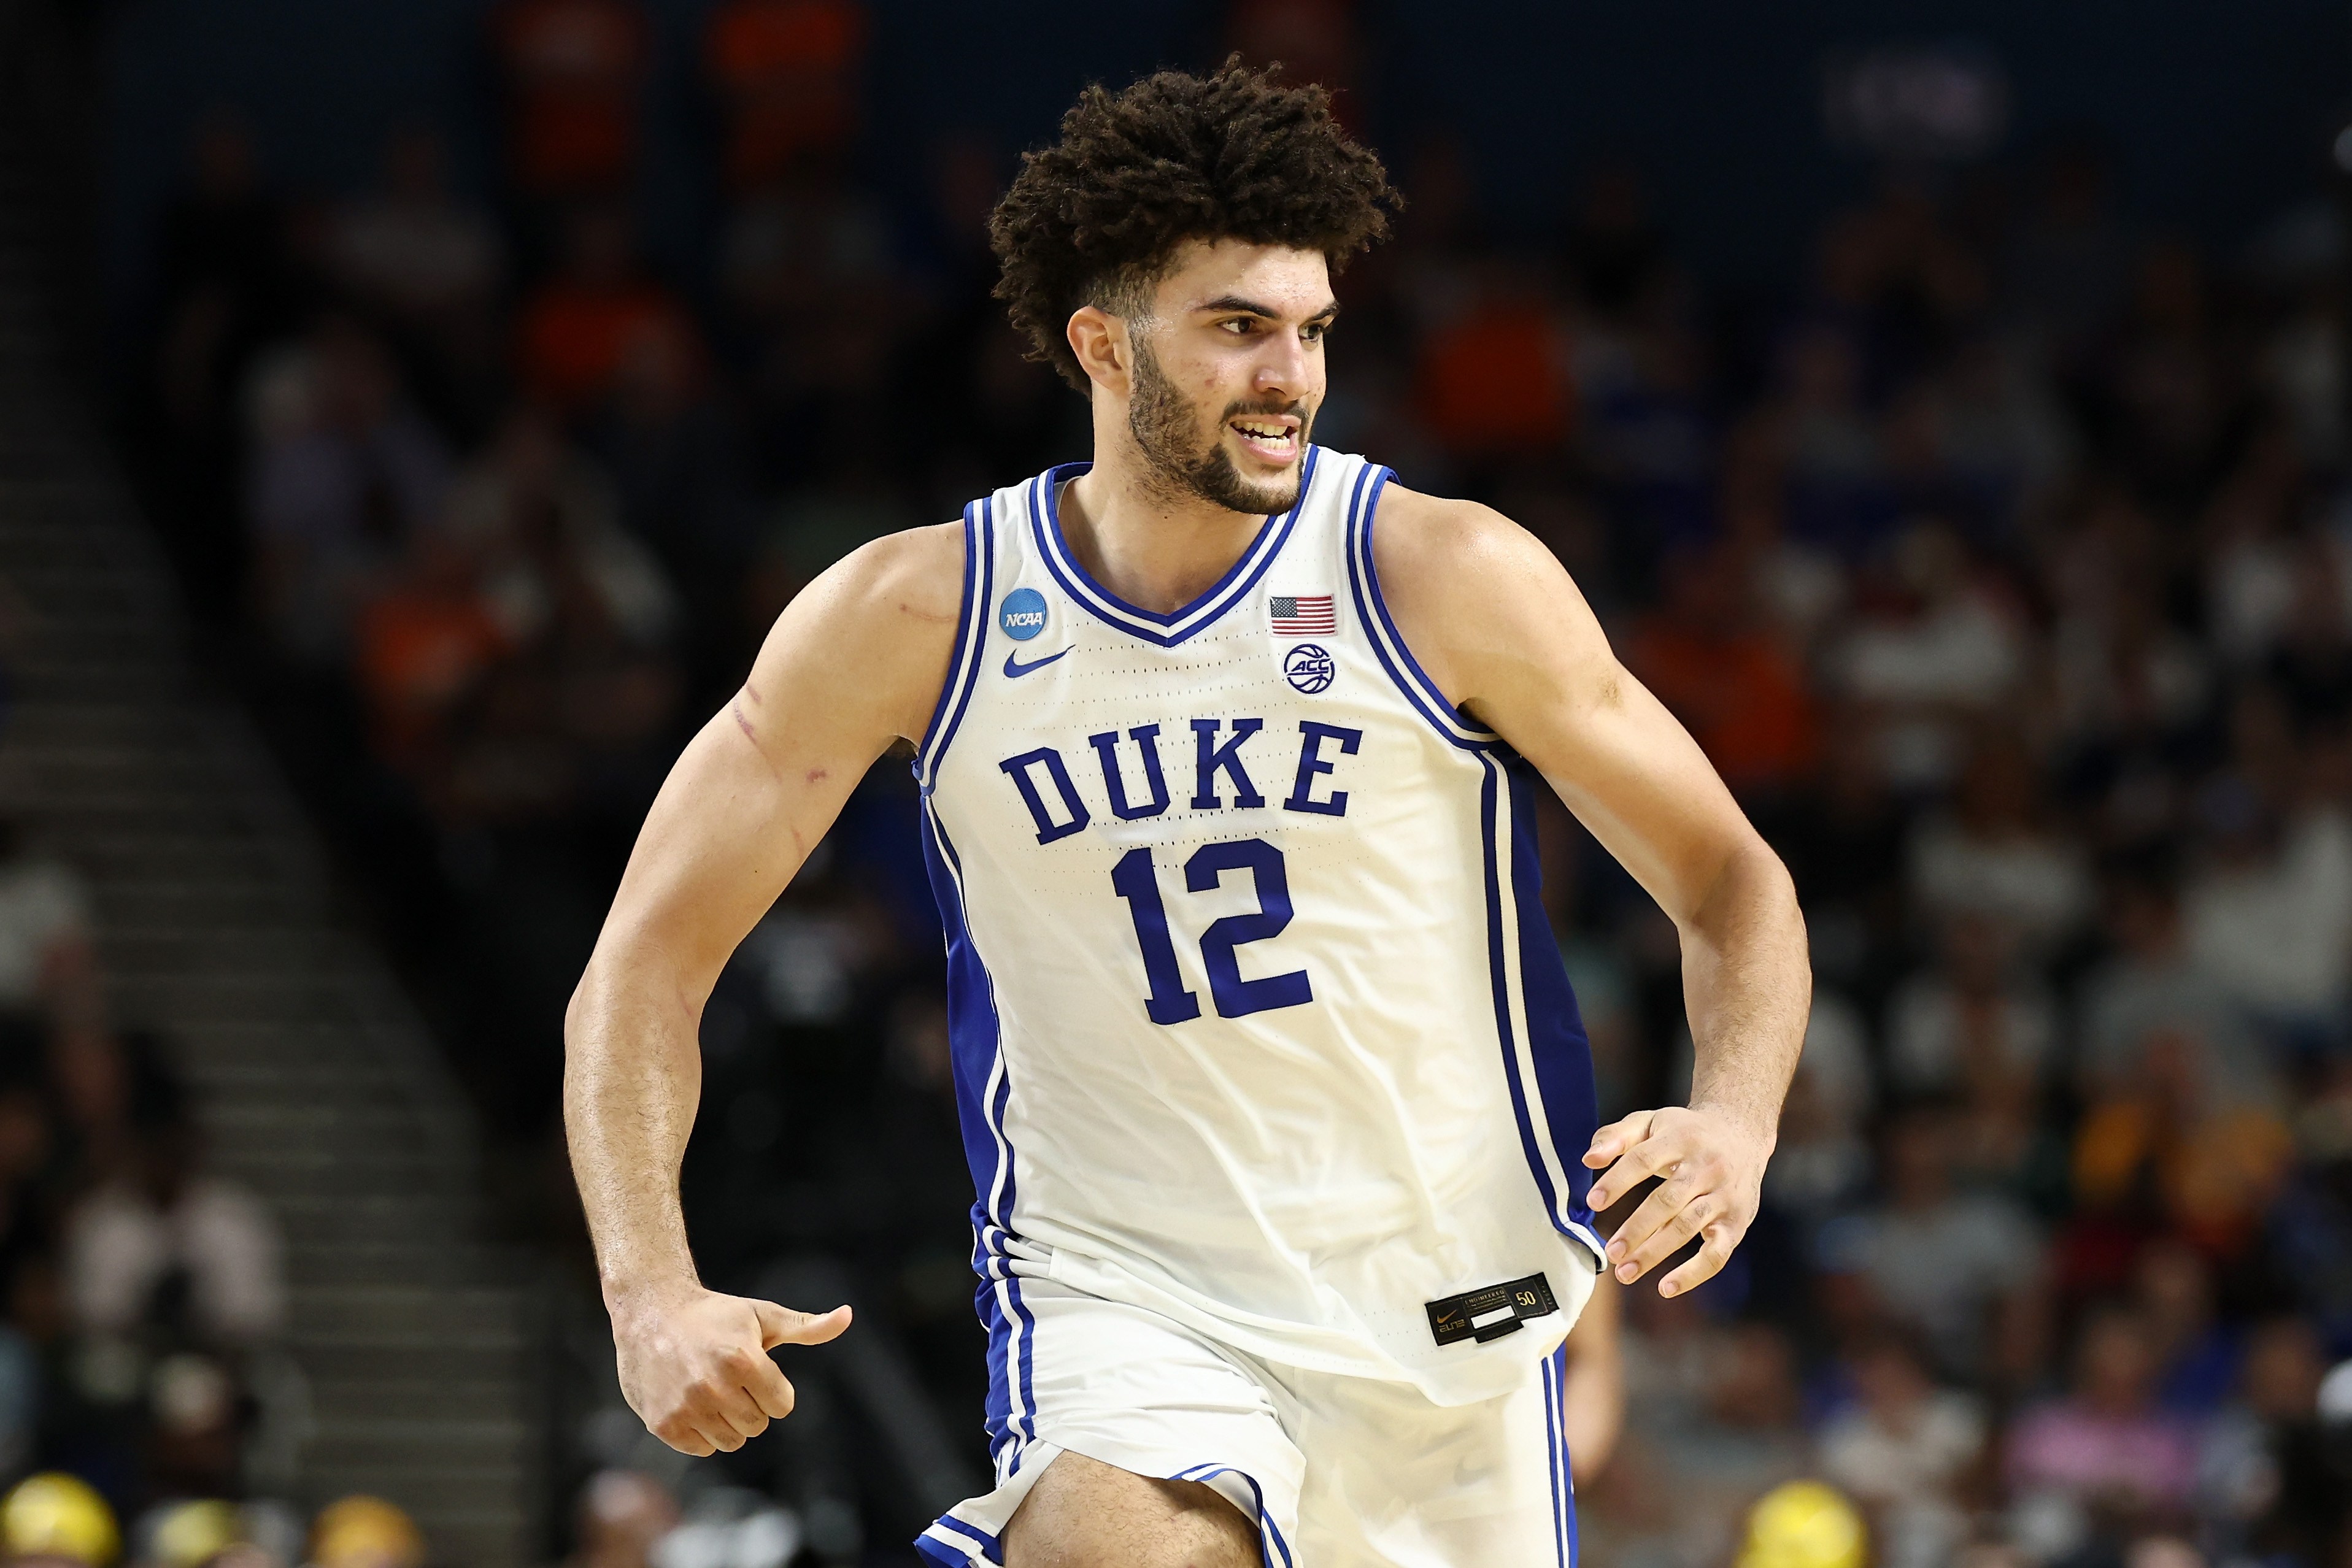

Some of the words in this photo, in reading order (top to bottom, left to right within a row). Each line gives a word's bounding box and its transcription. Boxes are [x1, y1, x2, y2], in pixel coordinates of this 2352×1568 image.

[1005, 612, 1043, 628] NCAA
[1291, 658, 1331, 672] ACC
[998, 718, 1362, 845] DUKE
[1111, 838, 1313, 1025] 12
[1515, 1291, 1537, 1307] 50
